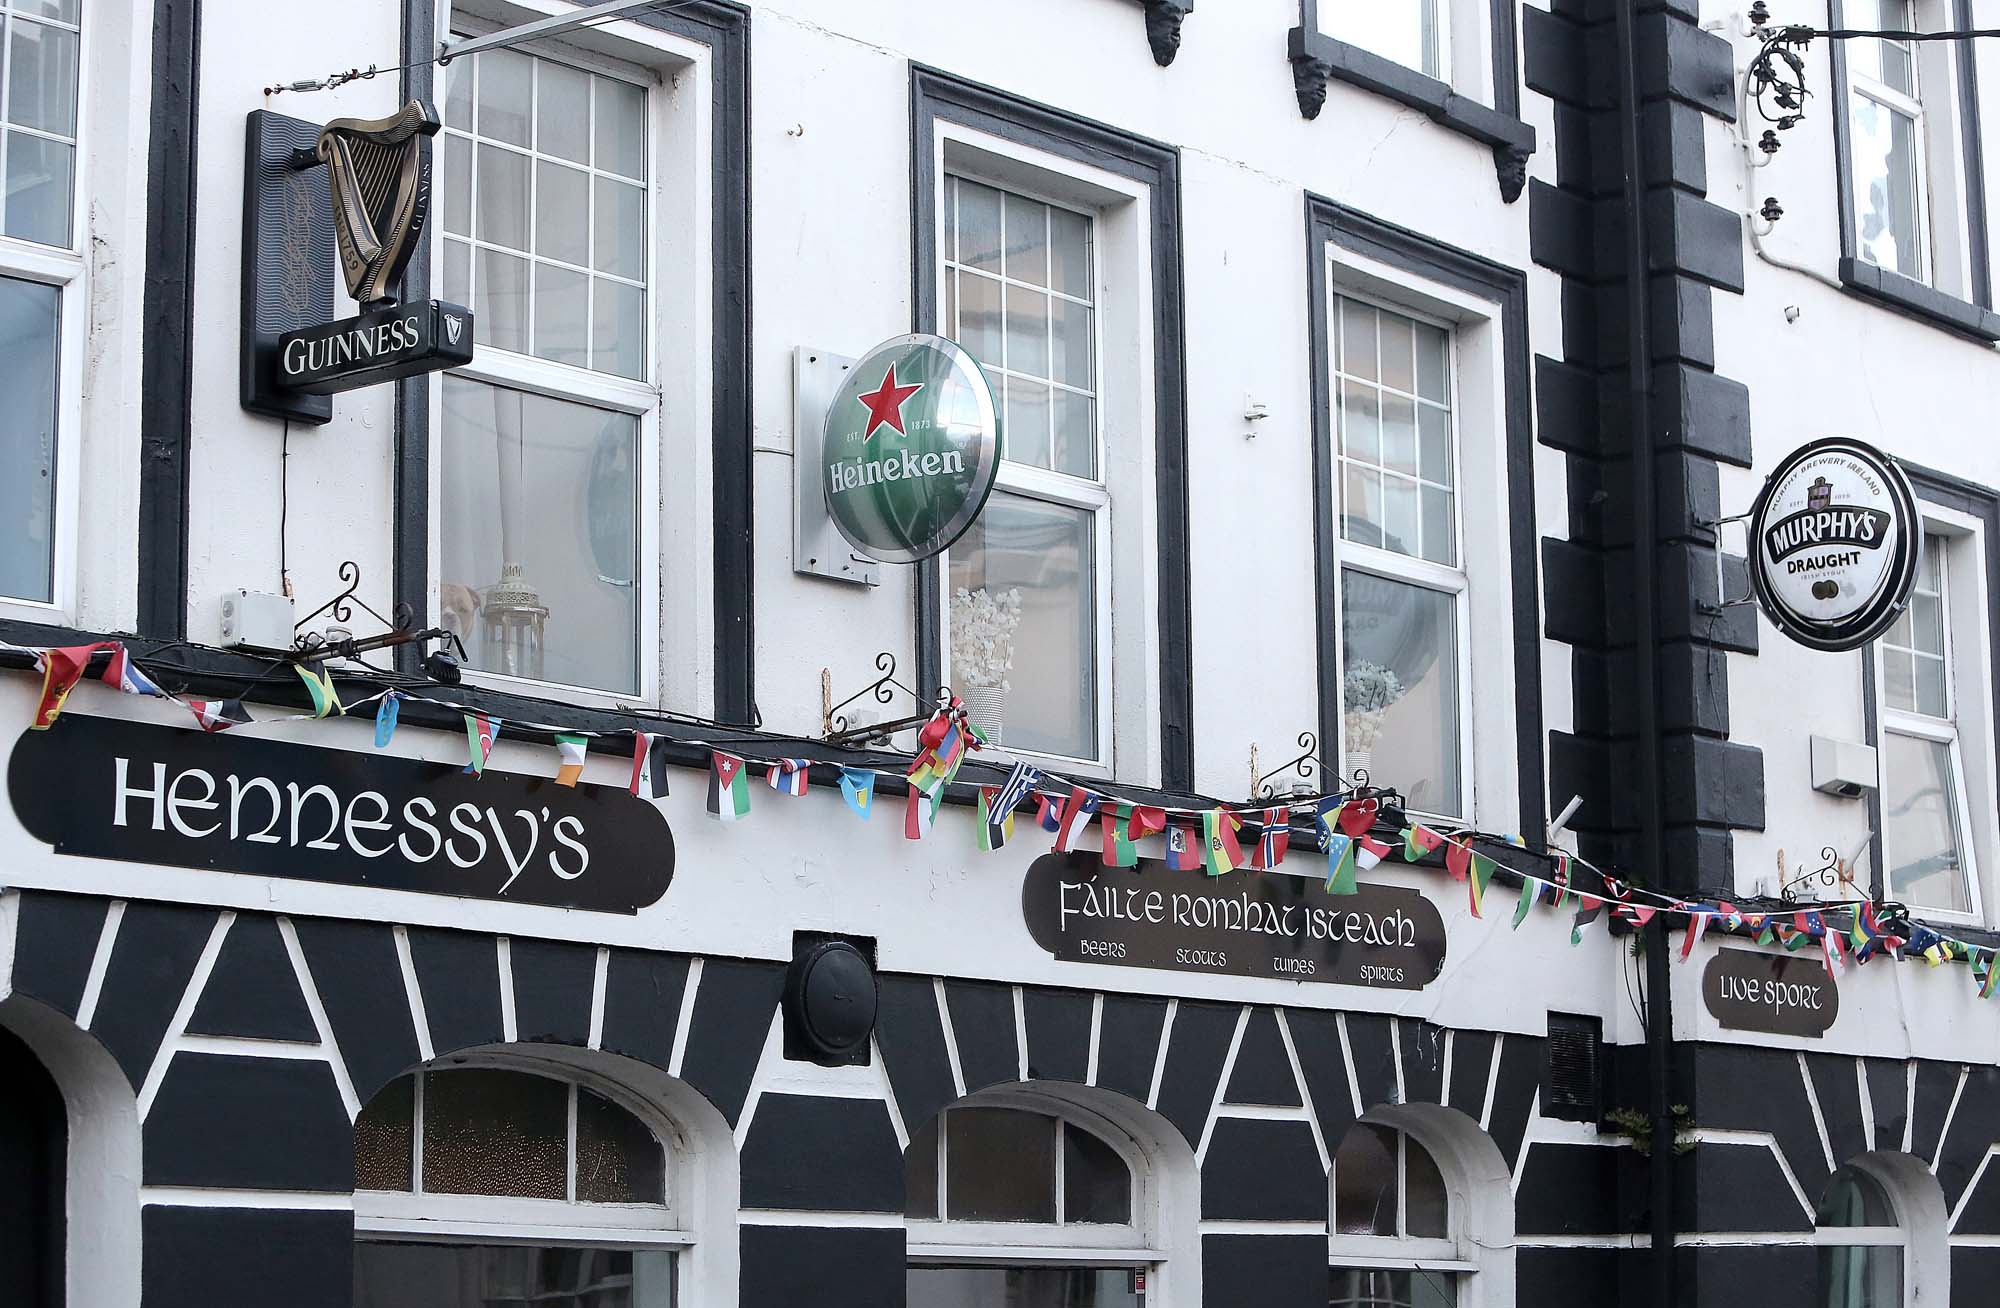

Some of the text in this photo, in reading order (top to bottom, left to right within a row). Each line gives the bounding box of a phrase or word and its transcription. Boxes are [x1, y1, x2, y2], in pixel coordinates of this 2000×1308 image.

[341, 232, 359, 271] 1759
[283, 316, 420, 375] GUINNESS
[911, 420, 931, 431] 1873
[829, 447, 966, 494] Heineken
[1772, 456, 1881, 512] MURPHY BREWERY IRELAND
[1771, 511, 1877, 556] MURPHY'S
[1787, 551, 1862, 575] DRAUGHT
[113, 756, 590, 895] Hennessy's
[1059, 875, 1166, 932] Fáilte
[1080, 939, 1127, 958] Beers
[1720, 975, 1760, 1003] Live
